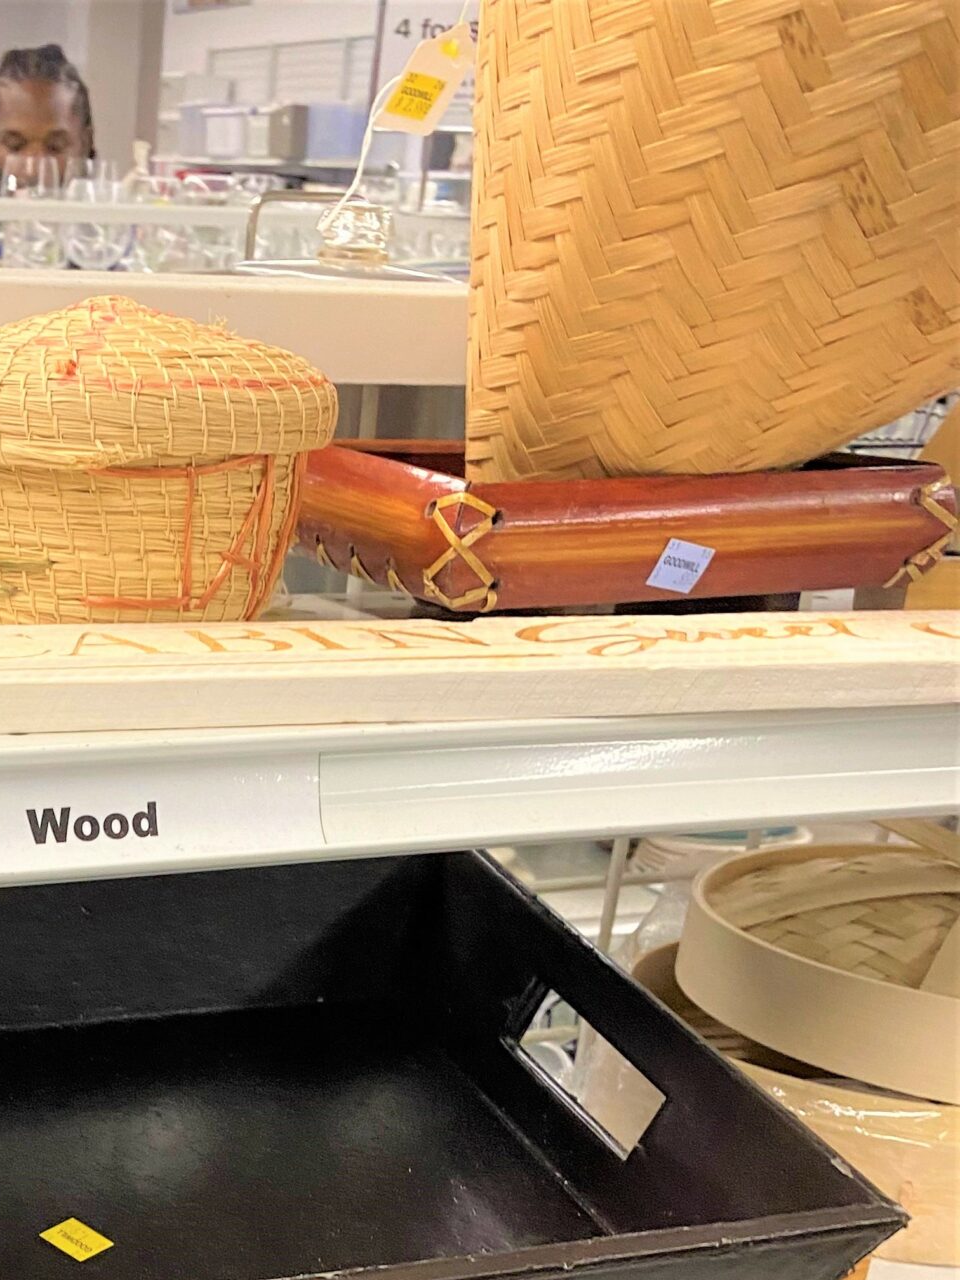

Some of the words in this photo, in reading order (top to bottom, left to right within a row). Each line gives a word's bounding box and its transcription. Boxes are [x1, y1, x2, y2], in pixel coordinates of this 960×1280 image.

[394, 18, 411, 38] 4
[663, 555, 699, 573] GOODWILL
[26, 801, 159, 845] Wood
